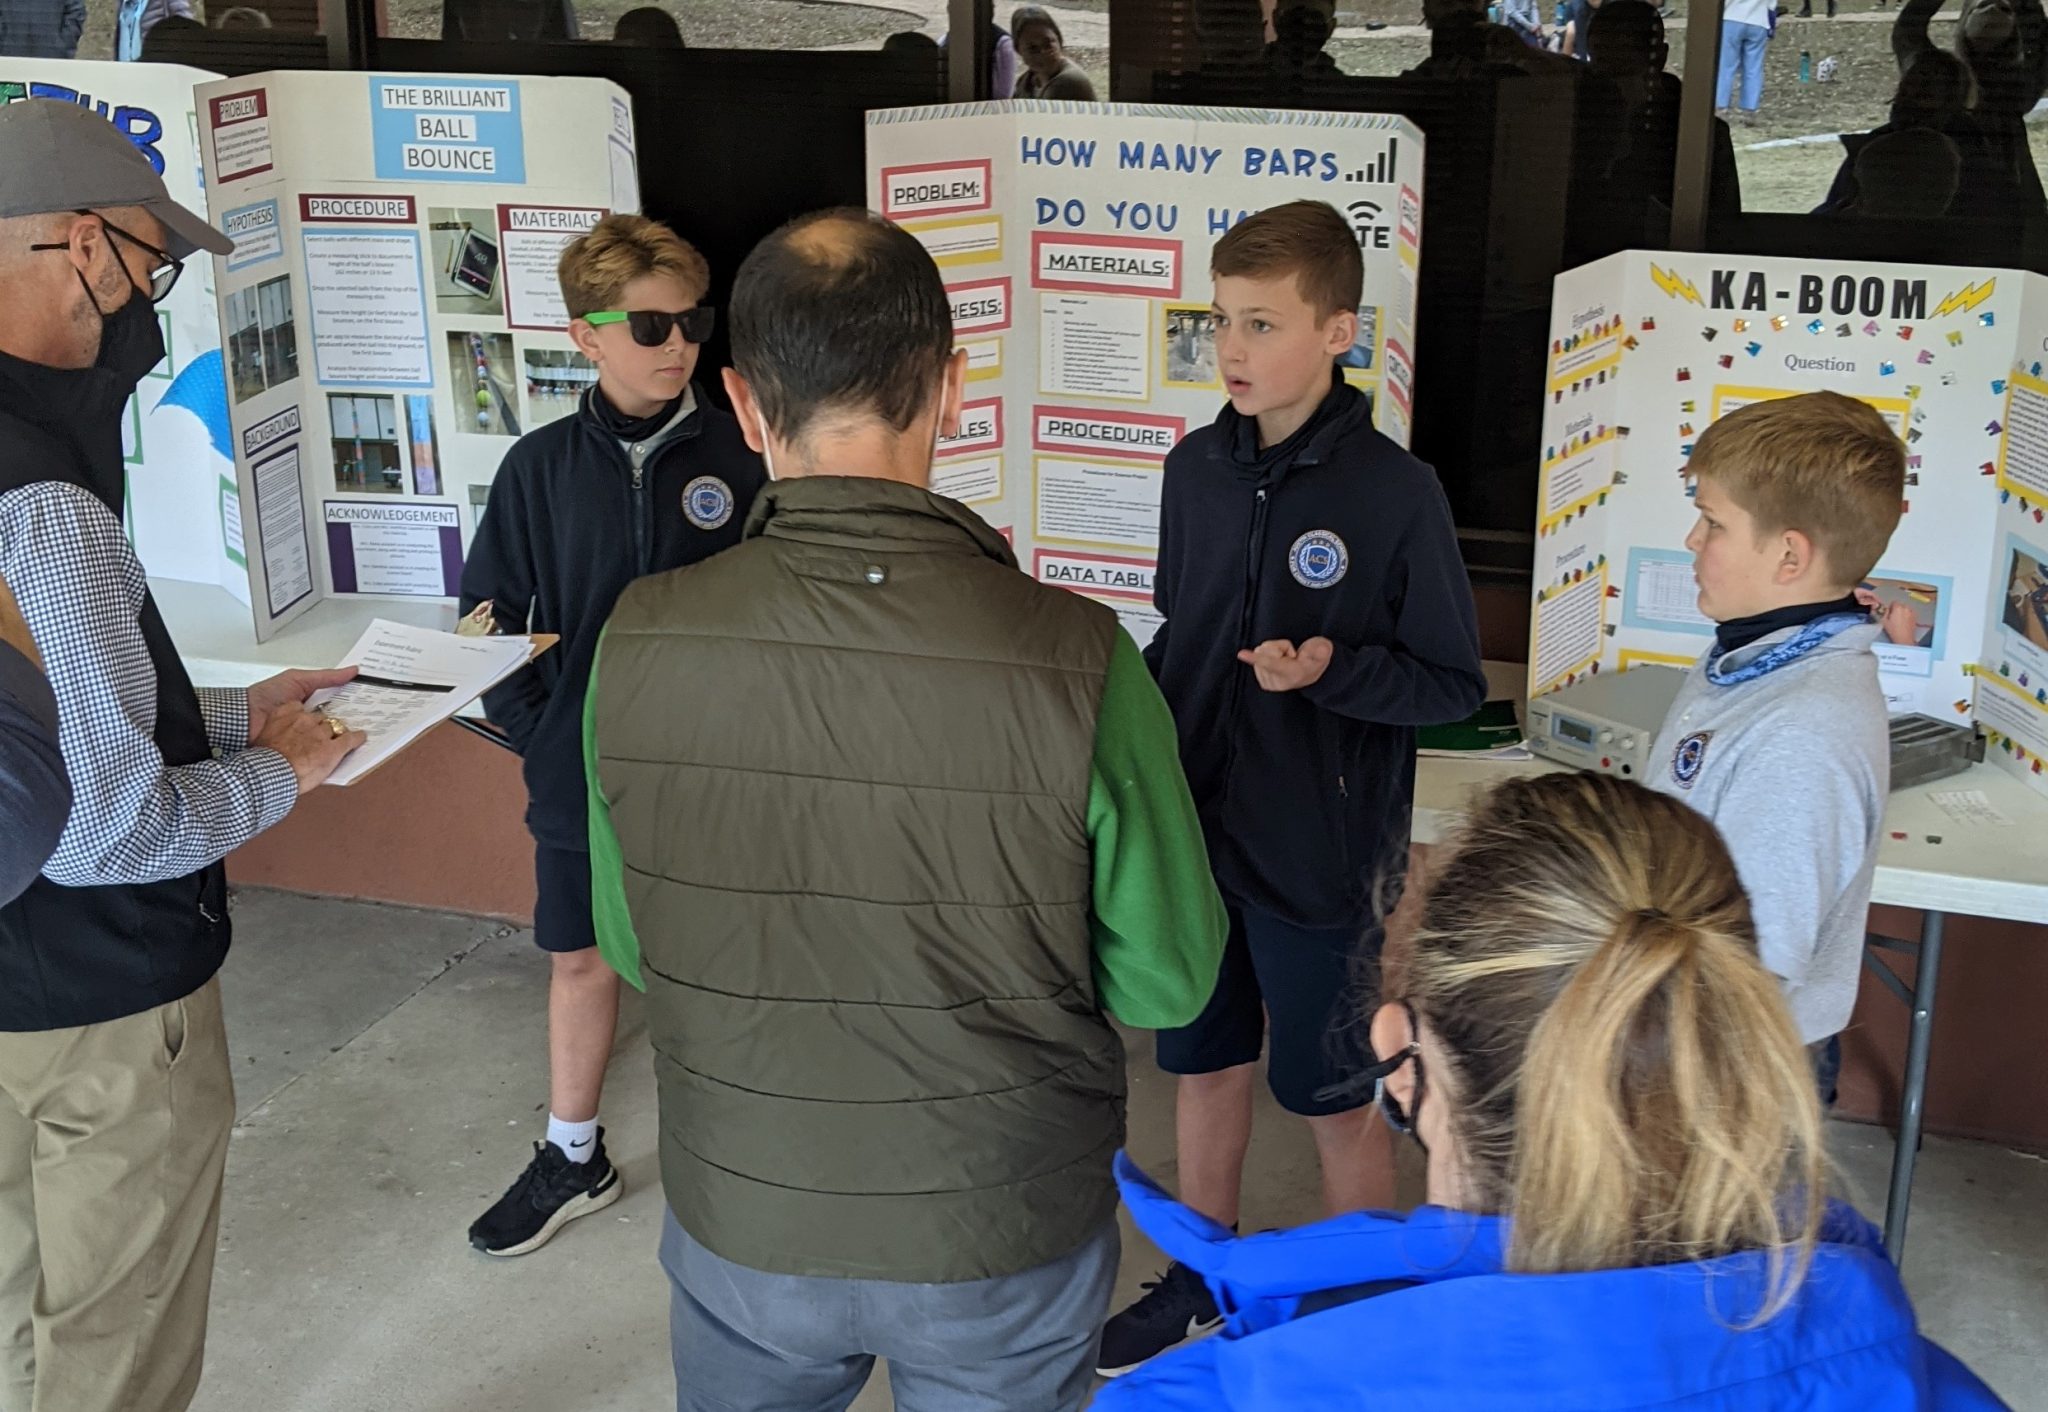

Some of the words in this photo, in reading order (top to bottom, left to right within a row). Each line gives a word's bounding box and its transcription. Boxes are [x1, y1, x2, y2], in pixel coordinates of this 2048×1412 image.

[384, 88, 418, 105] THE
[422, 89, 507, 108] BRILLIANT
[219, 99, 257, 120] PROBLEM
[420, 118, 469, 139] BALL
[407, 148, 494, 171] BOUNCE
[1020, 135, 1097, 168] HOW
[1119, 141, 1223, 174] MANY
[1243, 147, 1339, 182] BARS
[894, 181, 980, 203] PROBLEM:
[310, 199, 407, 217] PROCEDURE
[1035, 197, 1085, 227] DO
[1106, 200, 1178, 232] YOU
[227, 206, 273, 235] HYPOTHESIS
[512, 211, 599, 229] MATERIALS
[1356, 225, 1391, 249] TE
[1049, 254, 1170, 276] MATERIALS:
[1711, 269, 1928, 320] KA-BOOM
[1784, 353, 1857, 373] Question
[246, 412, 297, 450] BACKGROUND
[1049, 420, 1172, 447] PROCEDURE:
[327, 507, 455, 523] ACKNOWLEDGEMENT
[1046, 564, 1096, 583] DATA
[1101, 569, 1152, 588] TABL
